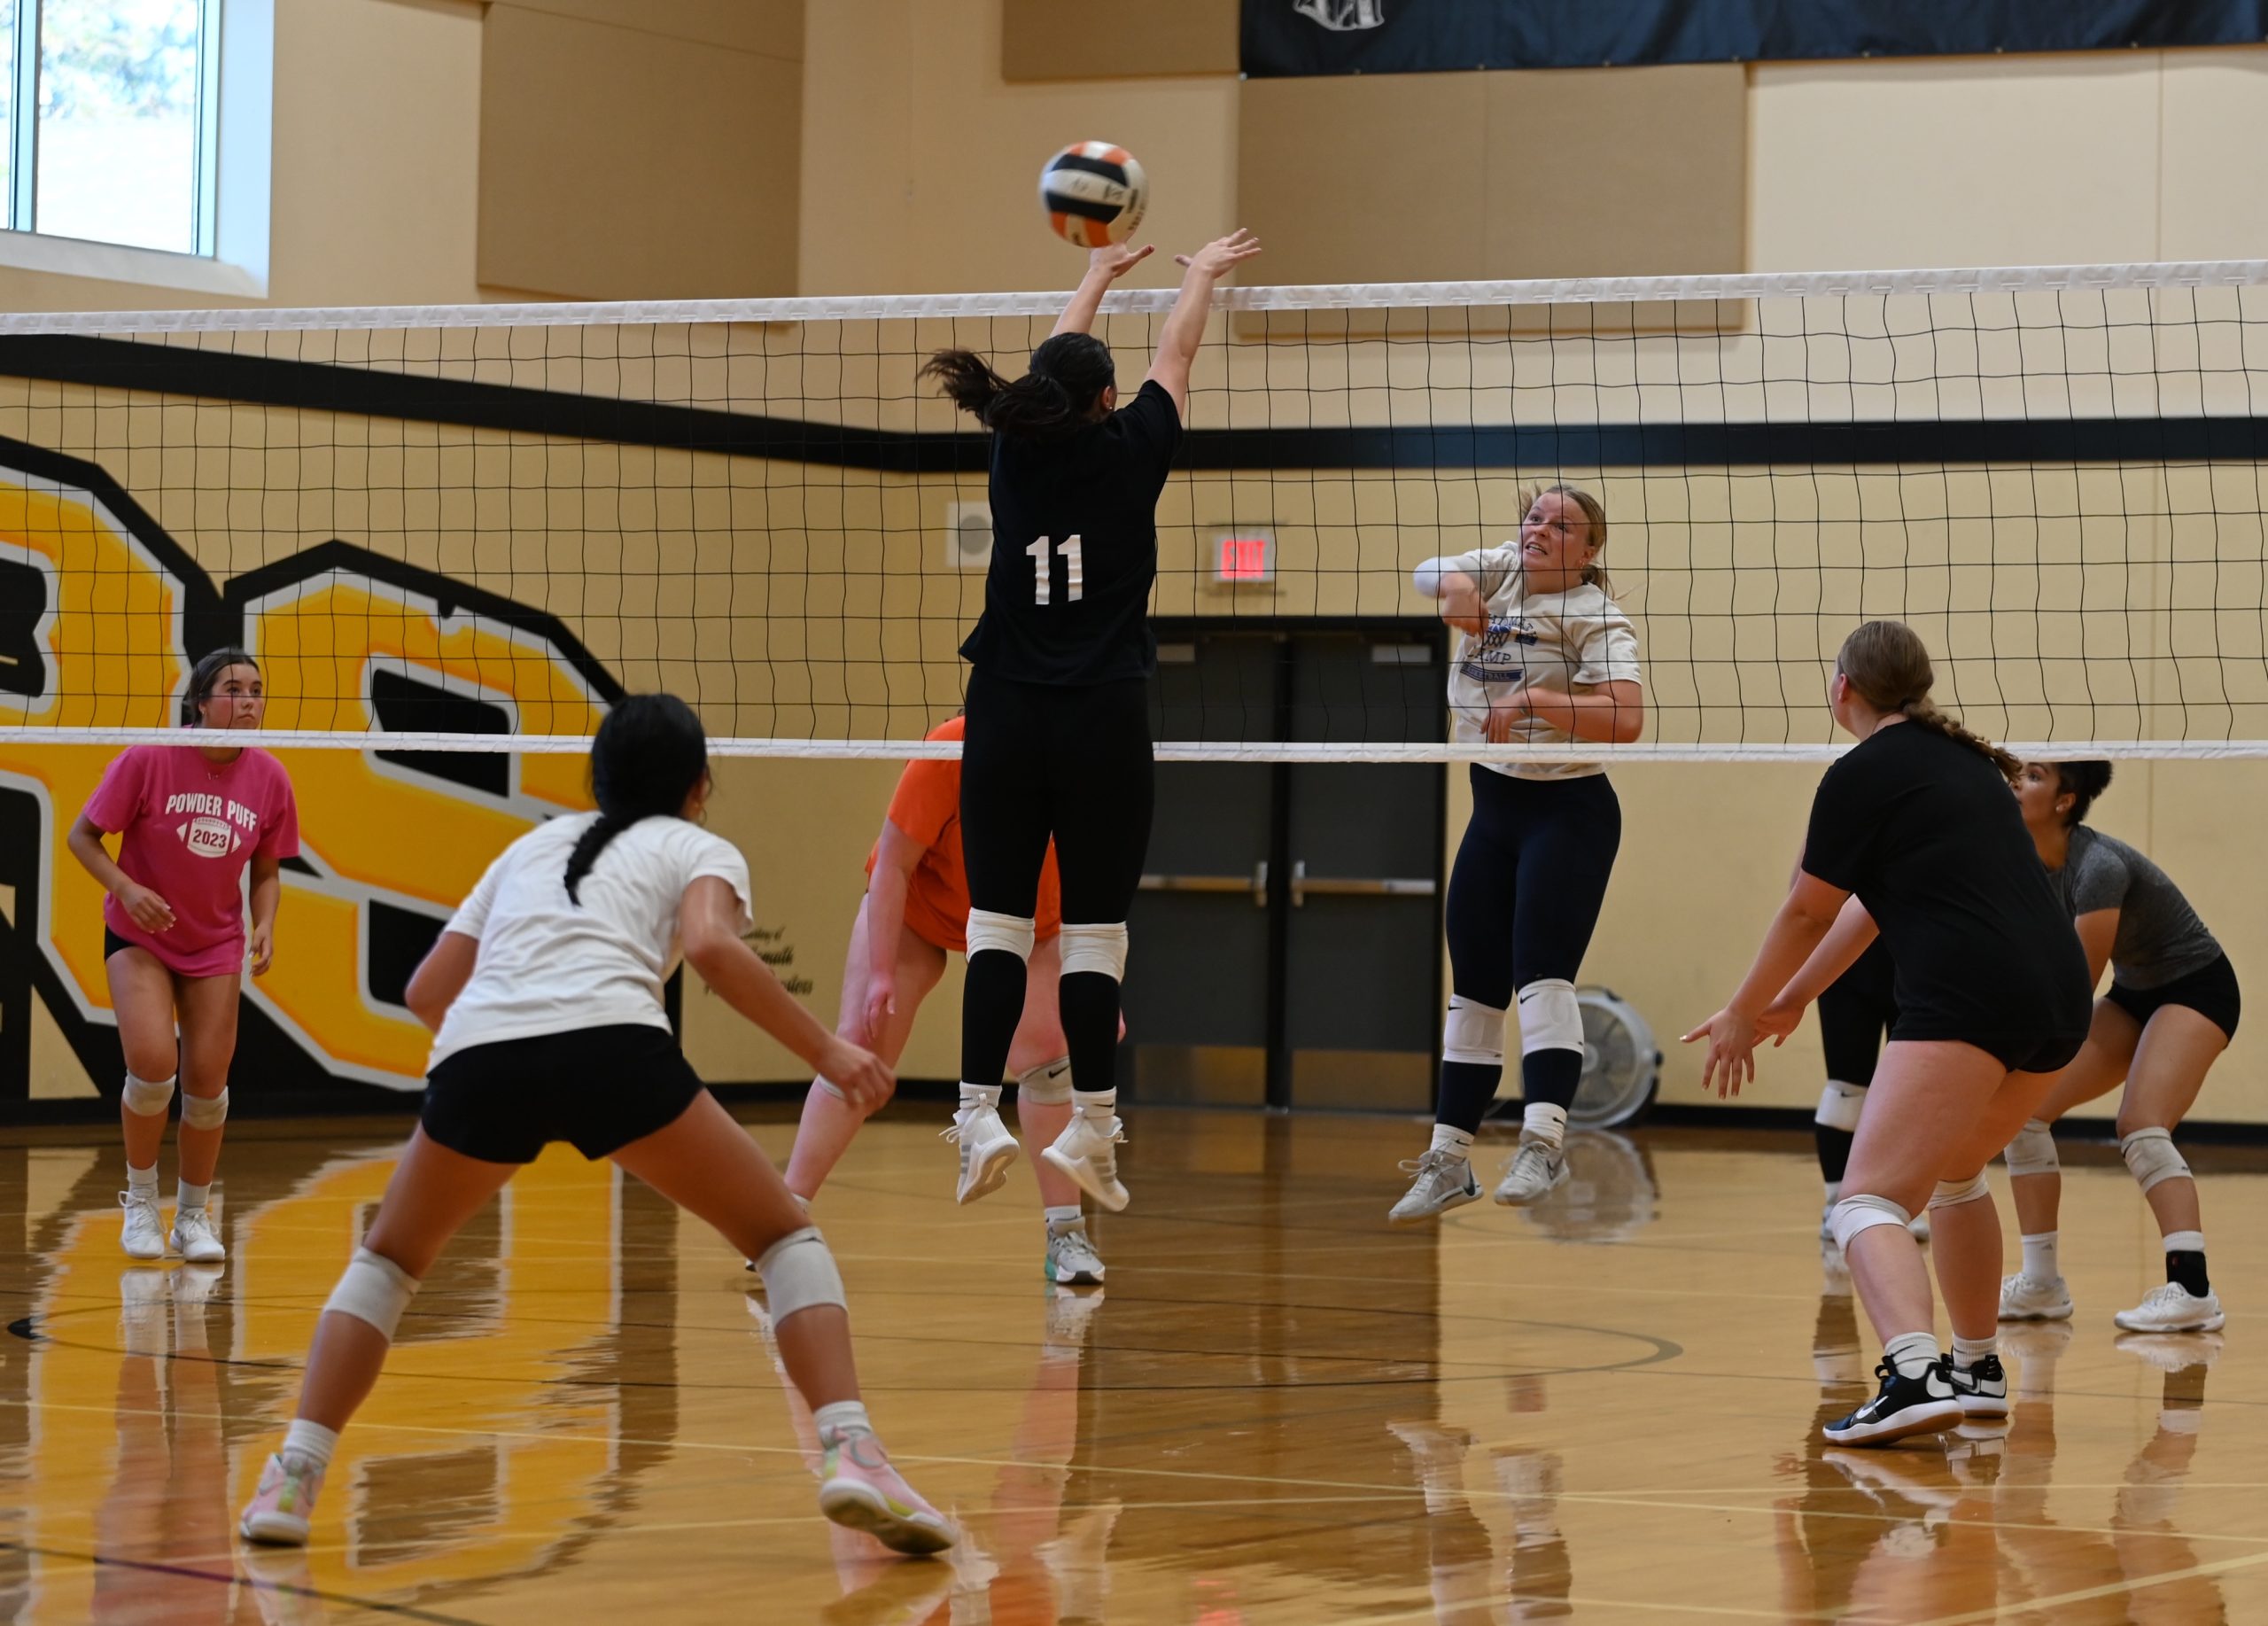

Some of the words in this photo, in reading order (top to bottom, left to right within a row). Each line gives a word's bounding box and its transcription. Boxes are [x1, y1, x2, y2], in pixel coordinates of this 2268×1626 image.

[1026, 534, 1083, 605] 11
[1467, 646, 1511, 665] AMP
[165, 793, 222, 817] POWDER
[227, 799, 258, 832] PUFF
[192, 829, 227, 849] 2023
